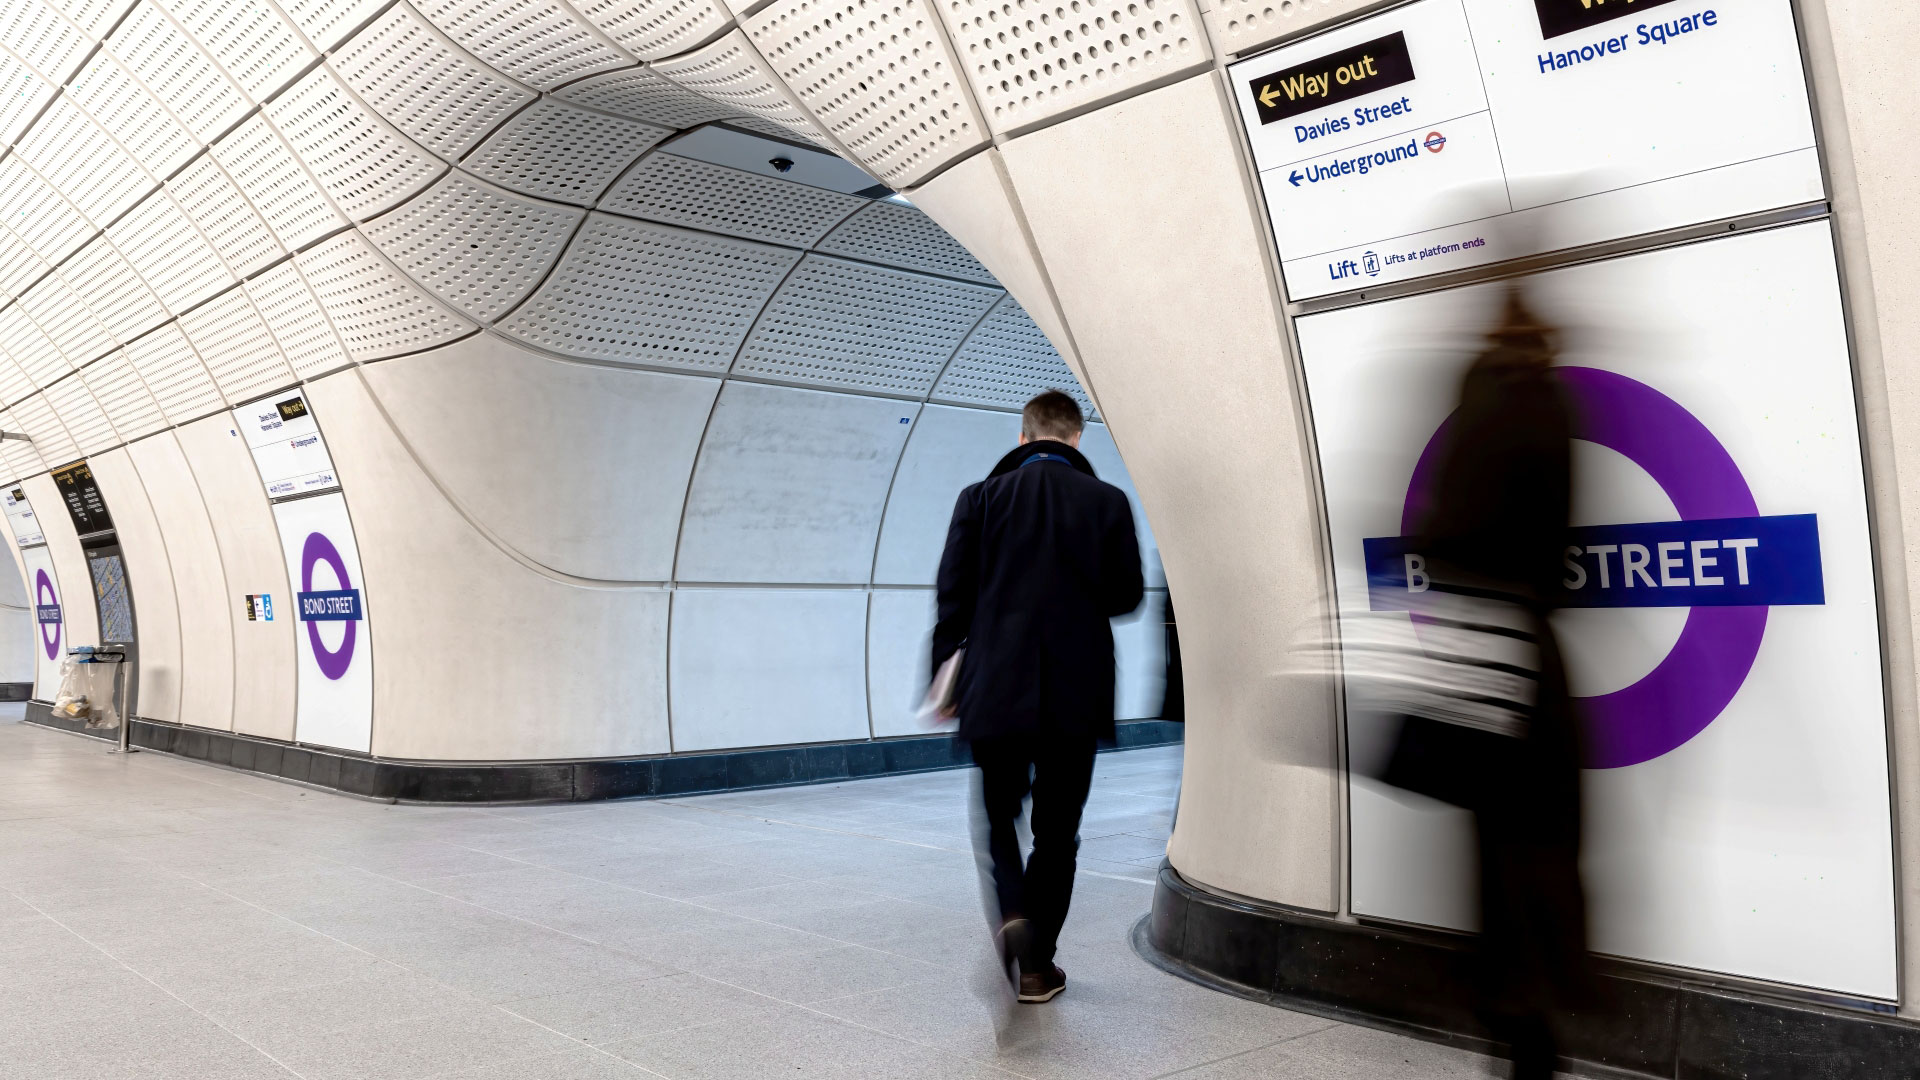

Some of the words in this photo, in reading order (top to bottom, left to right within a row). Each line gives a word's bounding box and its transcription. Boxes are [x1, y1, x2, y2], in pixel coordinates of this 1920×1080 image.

[1537, 34, 1629, 74] Hanover
[1636, 9, 1718, 45] Square
[1280, 72, 1329, 101] Way
[1335, 55, 1377, 85] out
[1294, 116, 1350, 143] Davies
[1355, 96, 1412, 126] Street
[1305, 139, 1419, 183] Underground
[1328, 260, 1359, 280] Lift
[1384, 252, 1406, 265] Lifts
[1407, 251, 1418, 261] at
[1419, 242, 1460, 260] platform
[1462, 237, 1486, 250] ends
[1560, 537, 1759, 591] STREET
[303, 598, 326, 615] BOND
[326, 596, 353, 614] STREET
